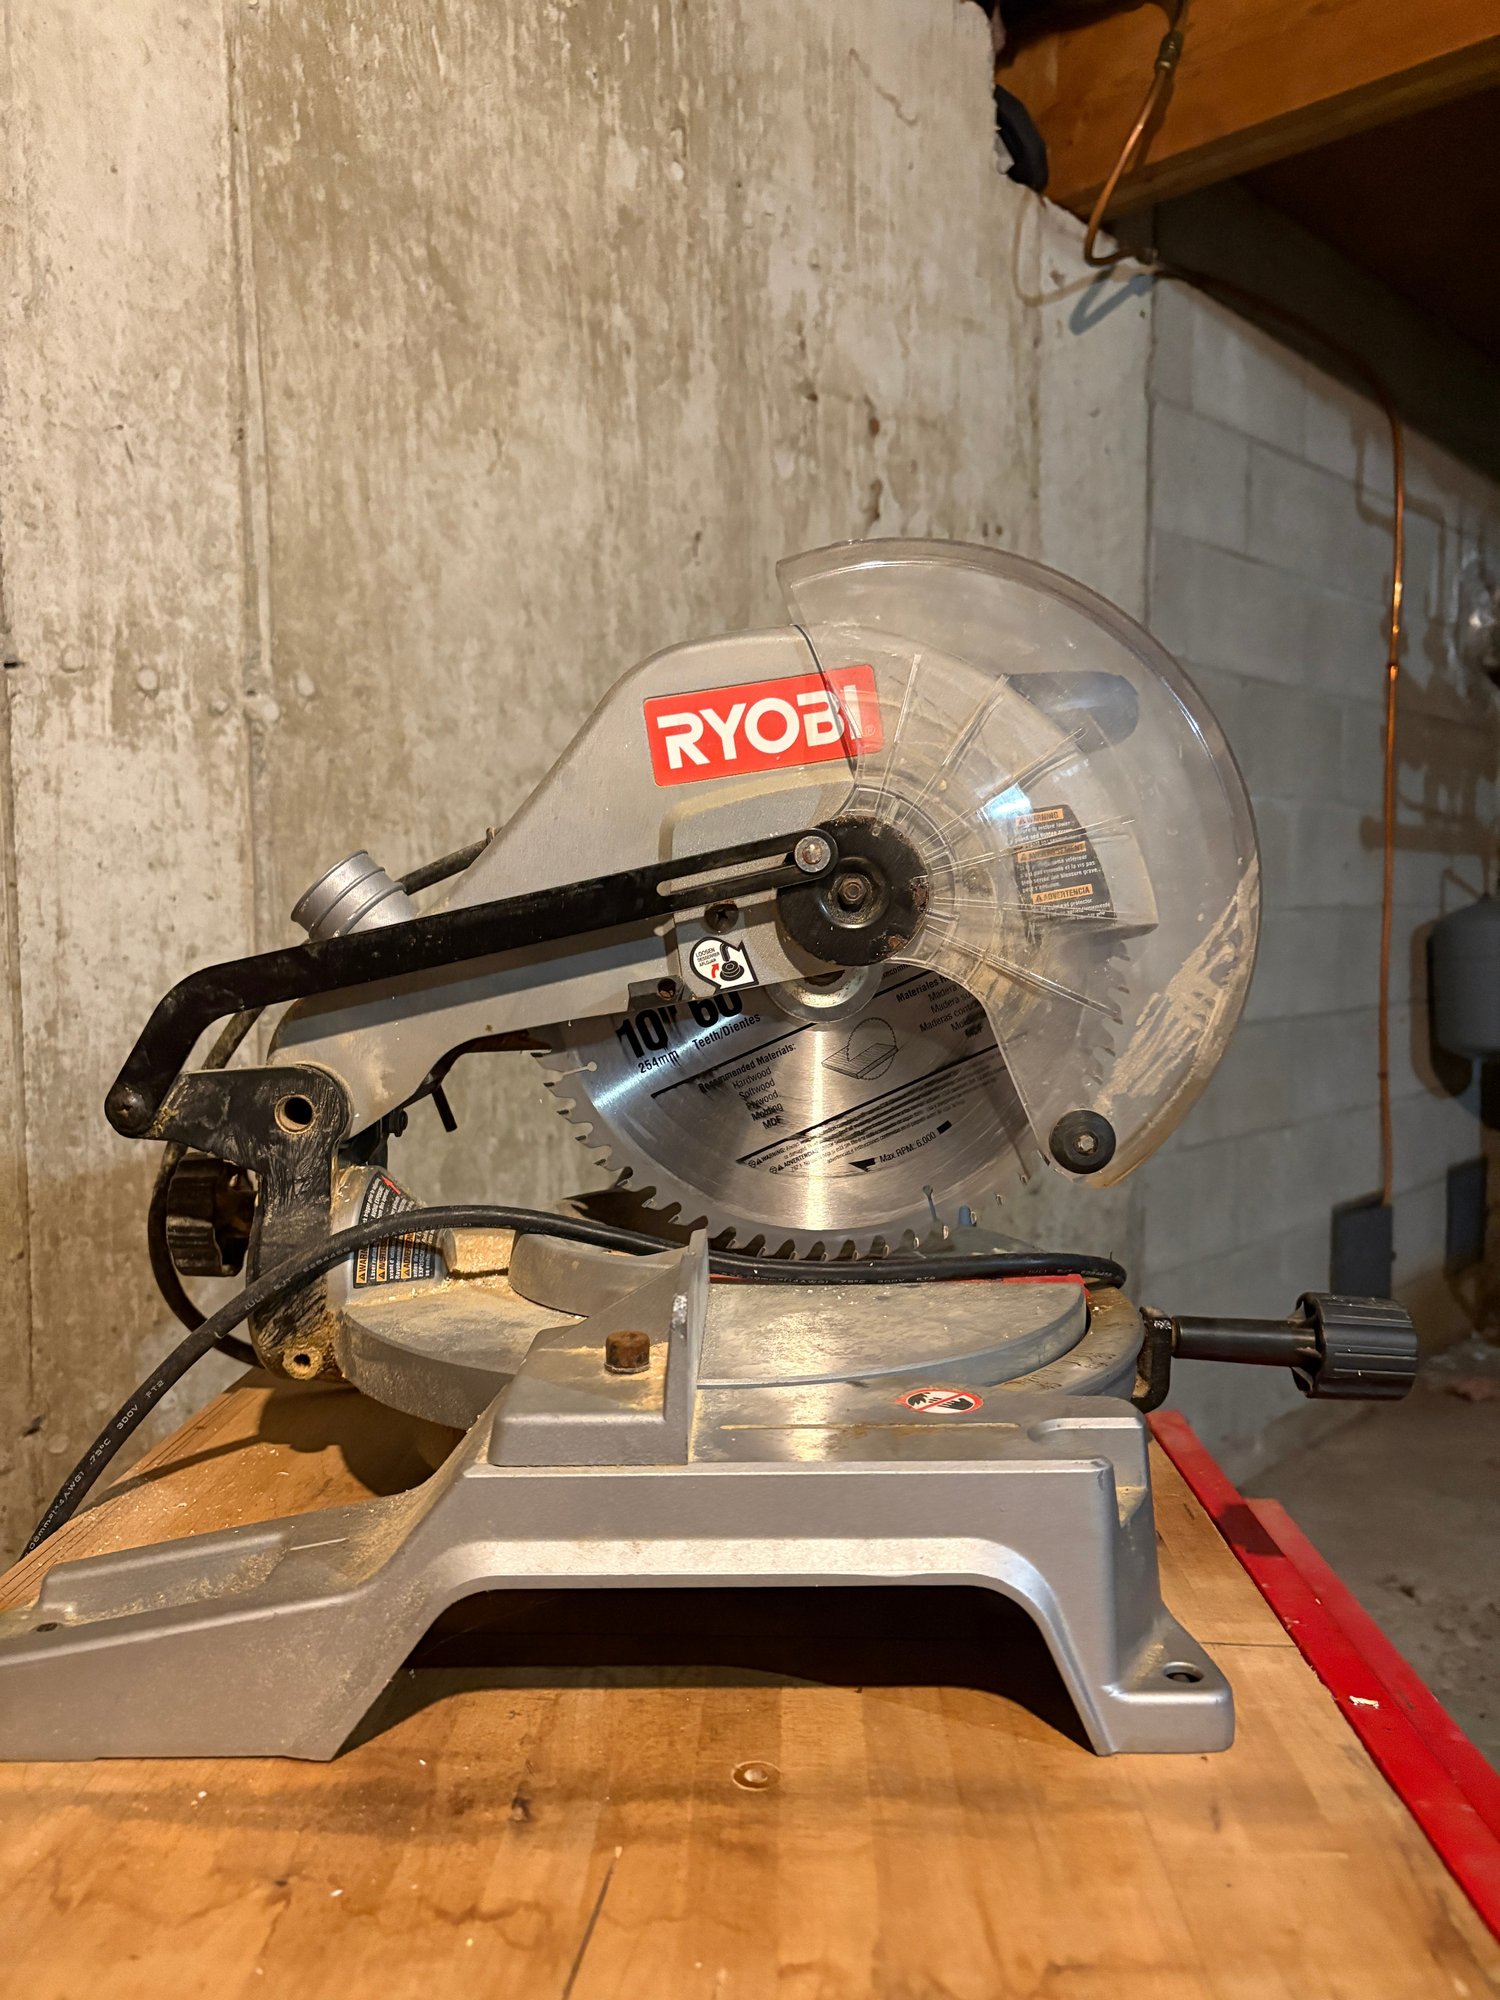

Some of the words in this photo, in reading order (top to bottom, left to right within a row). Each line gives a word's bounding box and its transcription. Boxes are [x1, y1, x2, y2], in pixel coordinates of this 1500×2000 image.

[657, 684, 862, 770] RYOBI
[1024, 811, 1058, 823] WARNING
[1044, 886, 1089, 900] ADVERTENCIA
[896, 979, 939, 1003] Materiales
[928, 984, 958, 1001] Madera
[930, 996, 960, 1013] Madera
[920, 1015, 953, 1032] Maderas
[638, 1050, 679, 1073] 254mm
[692, 1013, 761, 1050] Teeth/Dientes
[698, 1059, 756, 1091] Recommended
[757, 1043, 796, 1066] Materials:
[733, 1067, 772, 1089] Hardwood
[739, 1079, 775, 1100] Softwood
[763, 1115, 782, 1130] MDF
[880, 1150, 895, 1163] Max
[359, 1247, 368, 1272] WARN
[116, 1404, 138, 1430] 300V
[145, 1379, 165, 1400] FT2
